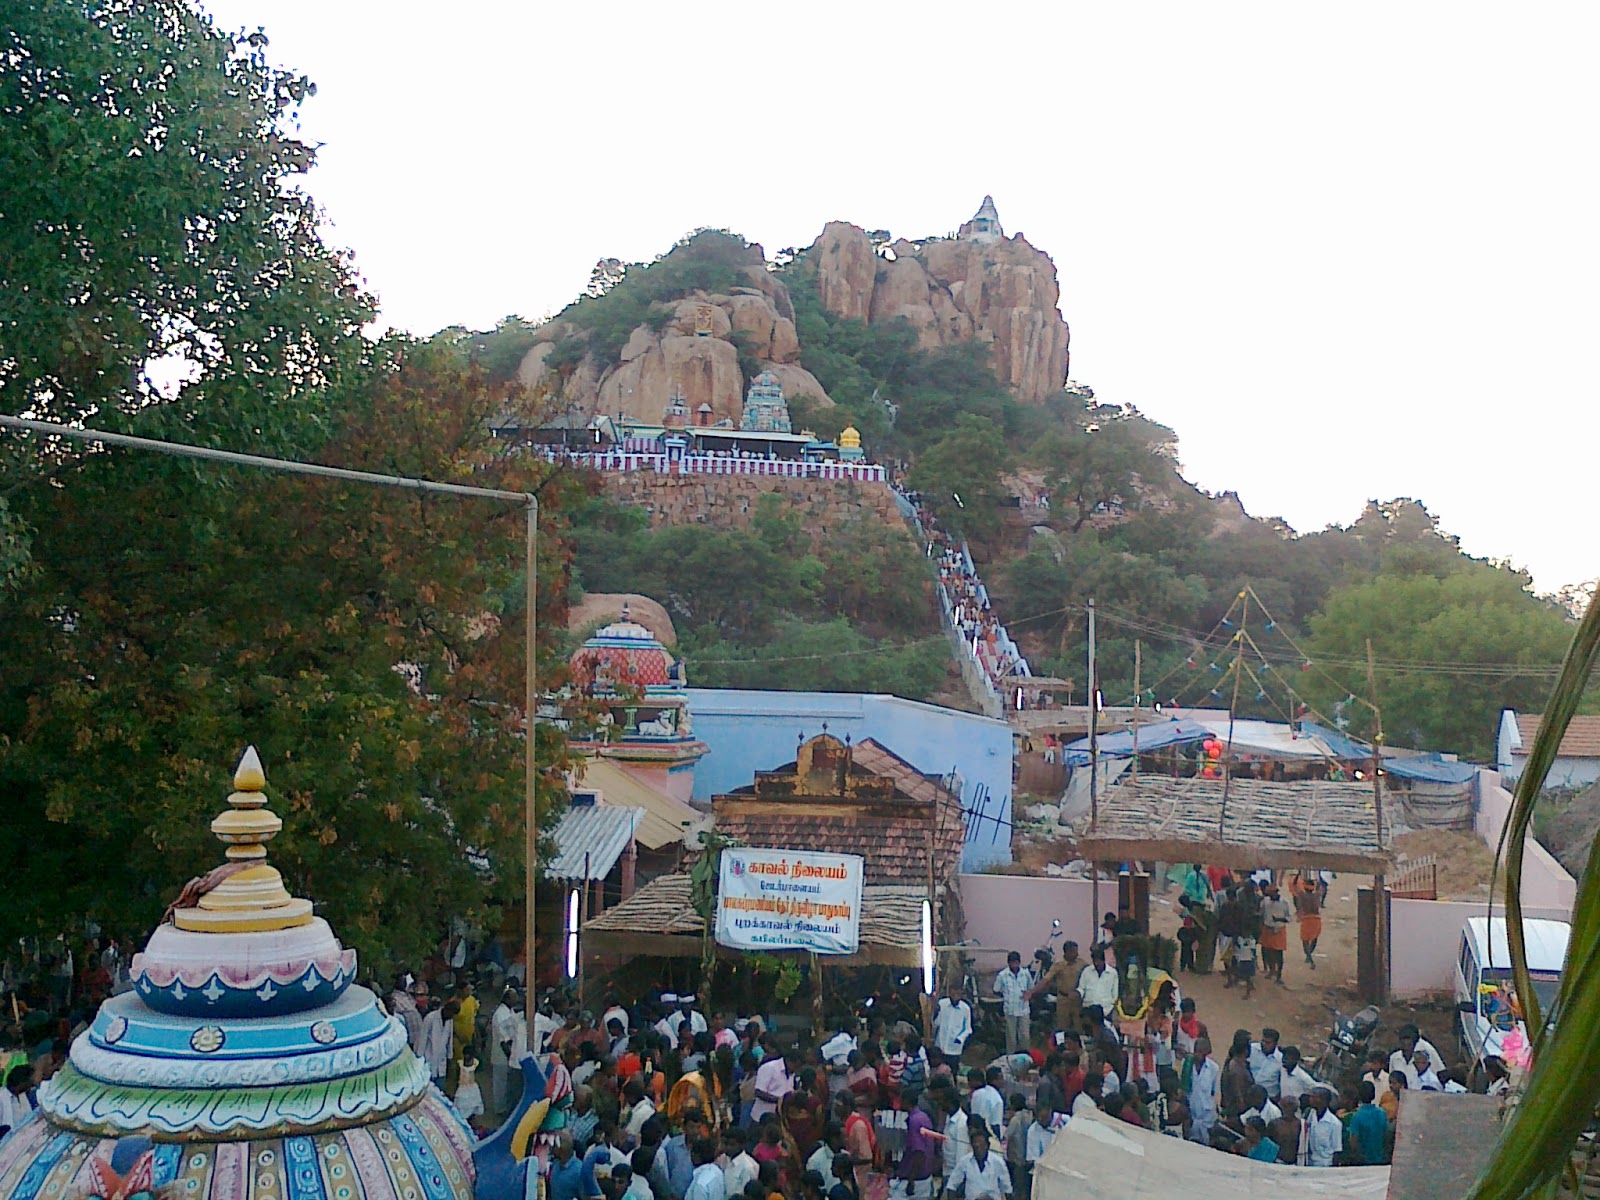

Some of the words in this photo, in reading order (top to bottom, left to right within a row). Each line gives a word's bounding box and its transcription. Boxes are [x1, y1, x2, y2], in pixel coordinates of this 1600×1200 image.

[748, 858, 790, 876] காவல்
[791, 859, 848, 880] நிலையம்
[735, 916, 792, 931] புறக்காவல்
[793, 919, 841, 934] நிலையம்
